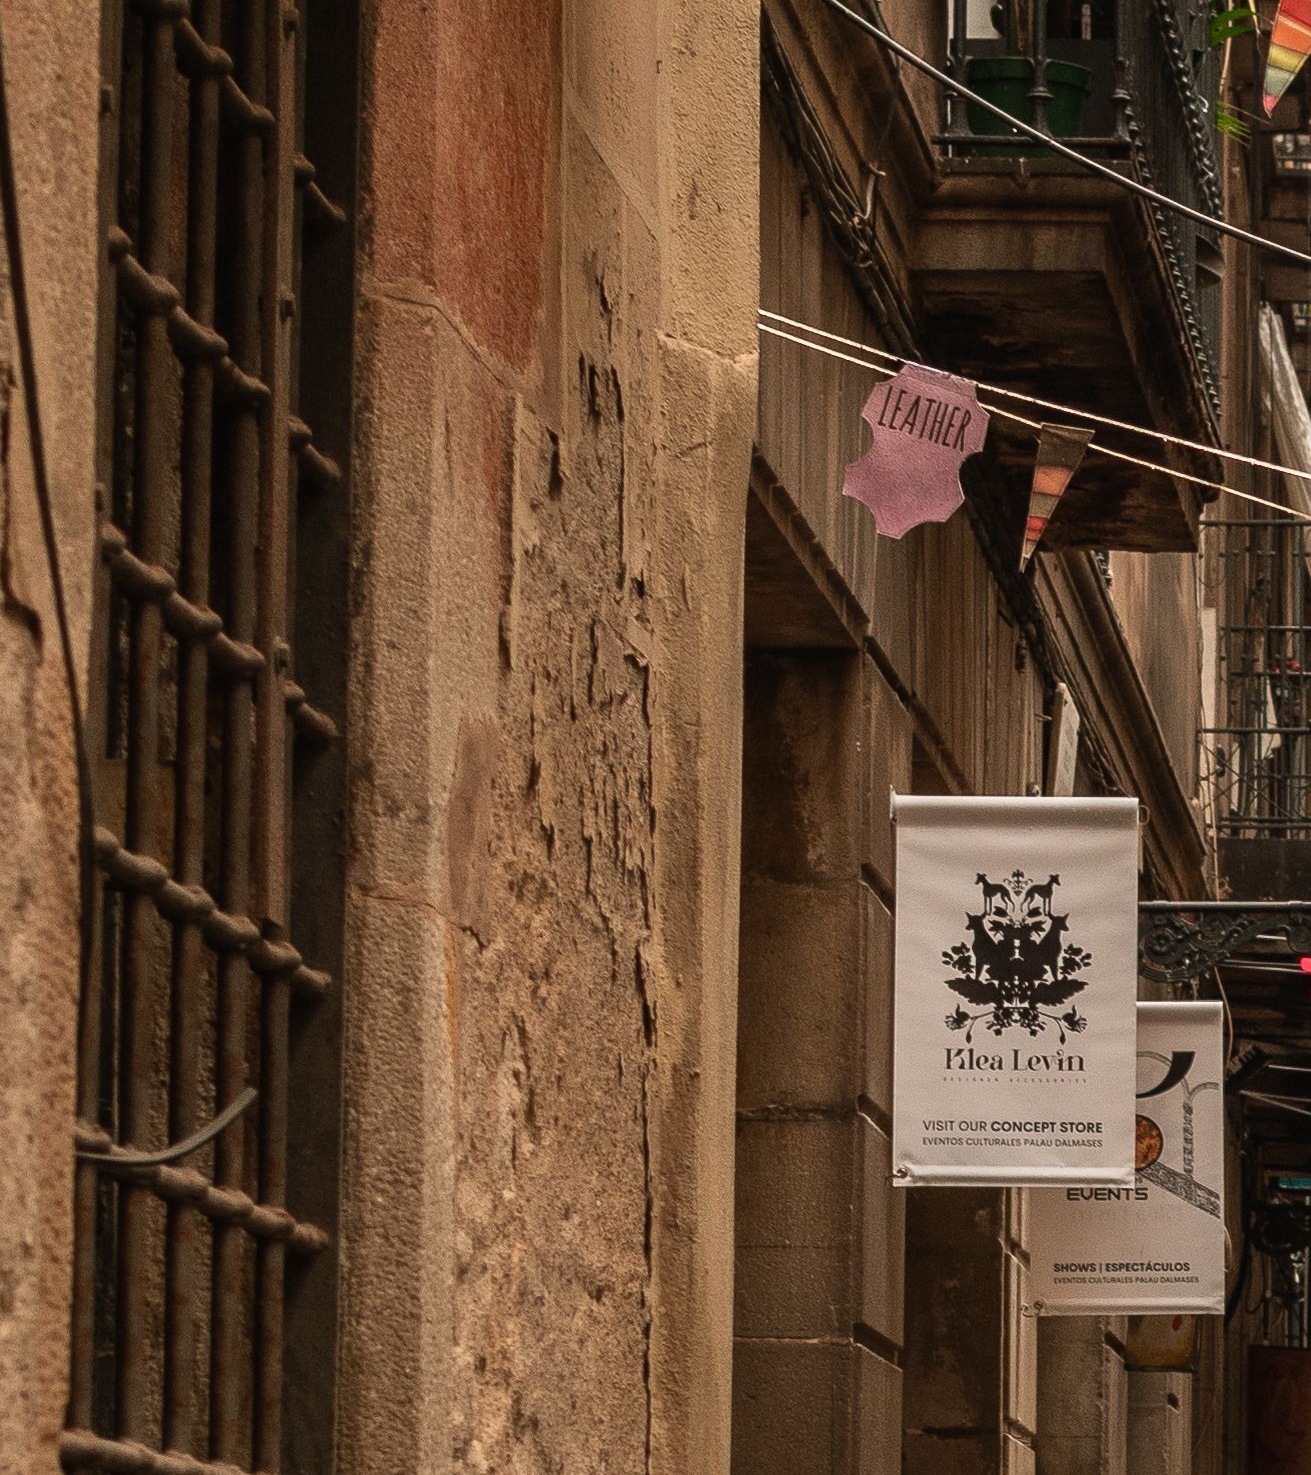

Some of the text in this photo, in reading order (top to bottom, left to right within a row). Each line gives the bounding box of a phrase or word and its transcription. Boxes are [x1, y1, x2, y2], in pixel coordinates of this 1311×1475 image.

[878, 385, 972, 451] LEATHER
[943, 1048, 1086, 1072] Klea Levin
[922, 1120, 1103, 1134] VISIT OUR CONCEPT STORE
[922, 1137, 1103, 1148] EVENTOS CULTURALES PALAU DALMASES
[1066, 1187, 1149, 1201] EVENTS
[1053, 1260, 1191, 1273] SHOWS ESPECTÁCULOS
[1053, 1276, 1200, 1285] EVENTOS CULTURALES PALAU DALMASES
